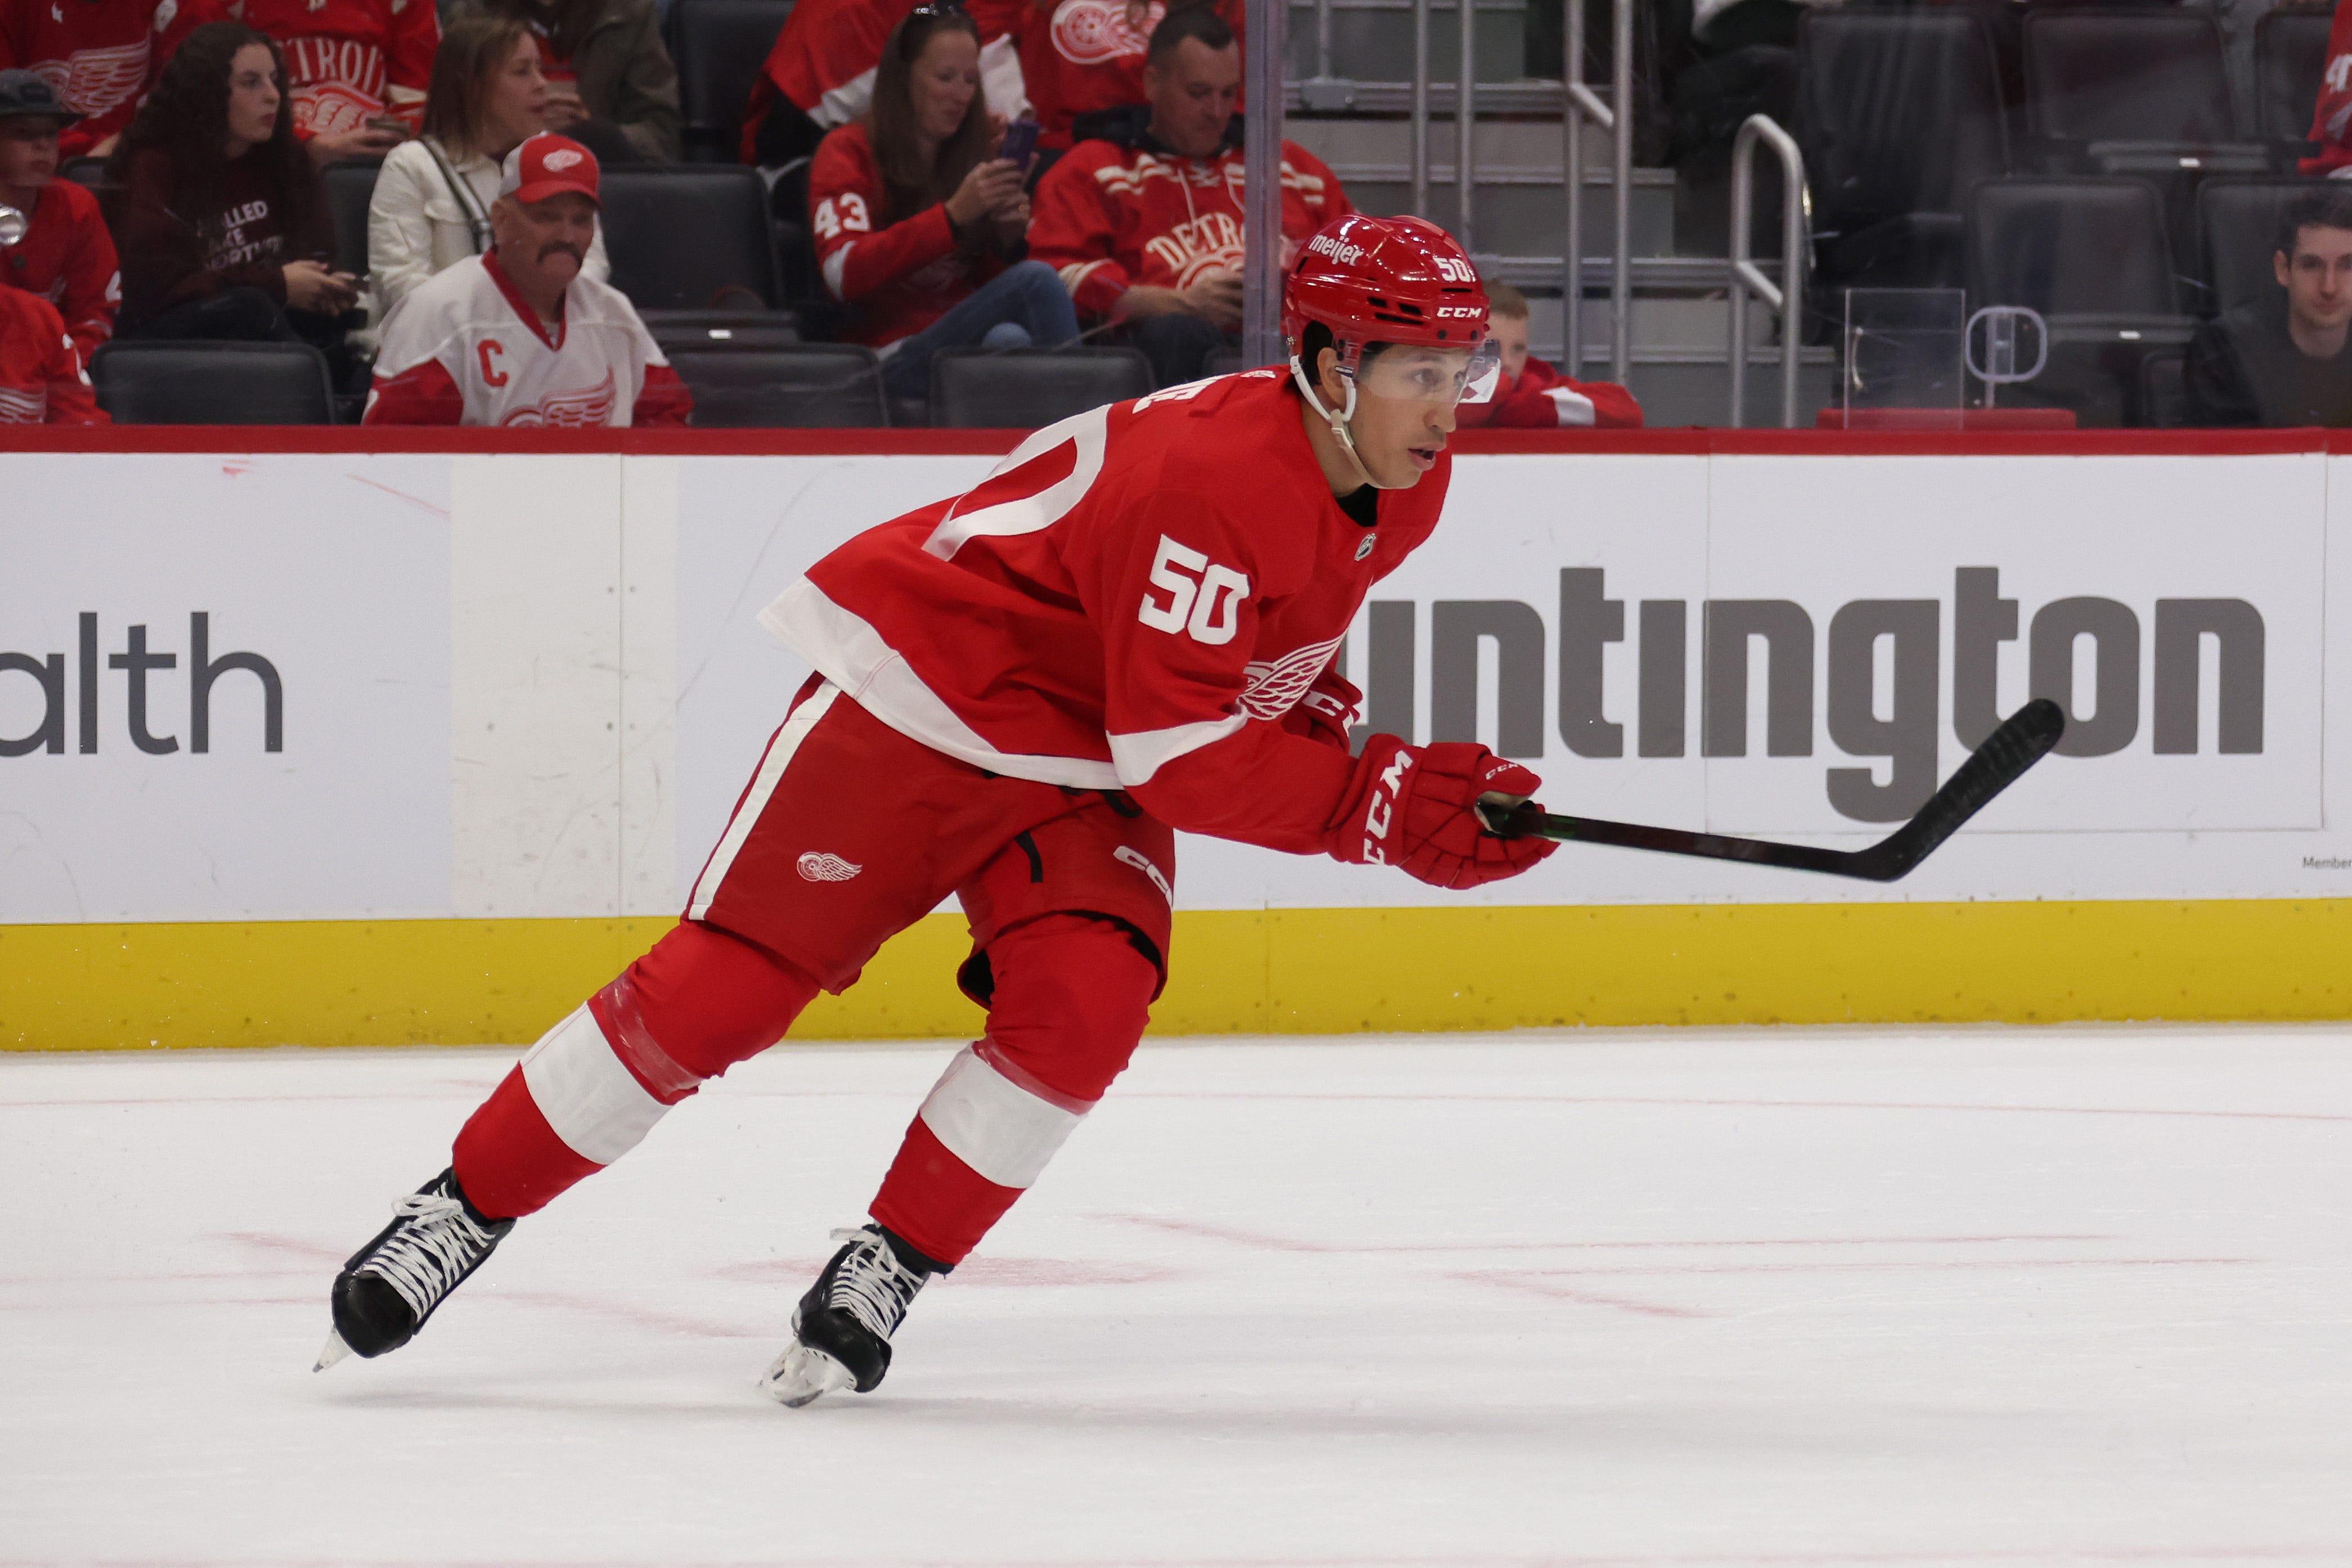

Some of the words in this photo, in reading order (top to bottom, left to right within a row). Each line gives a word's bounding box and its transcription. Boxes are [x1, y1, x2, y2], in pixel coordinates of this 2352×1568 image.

[276, 37, 386, 98] TROI
[814, 192, 869, 240] 43
[1145, 212, 1246, 273] DETR
[1308, 235, 1363, 266] meijer
[1433, 257, 1471, 282] 50
[1437, 307, 1482, 318] CCM
[477, 339, 509, 387] C
[1138, 533, 1250, 645] 50
[1336, 567, 2265, 823] untington
[1363, 750, 1413, 865] CCM
